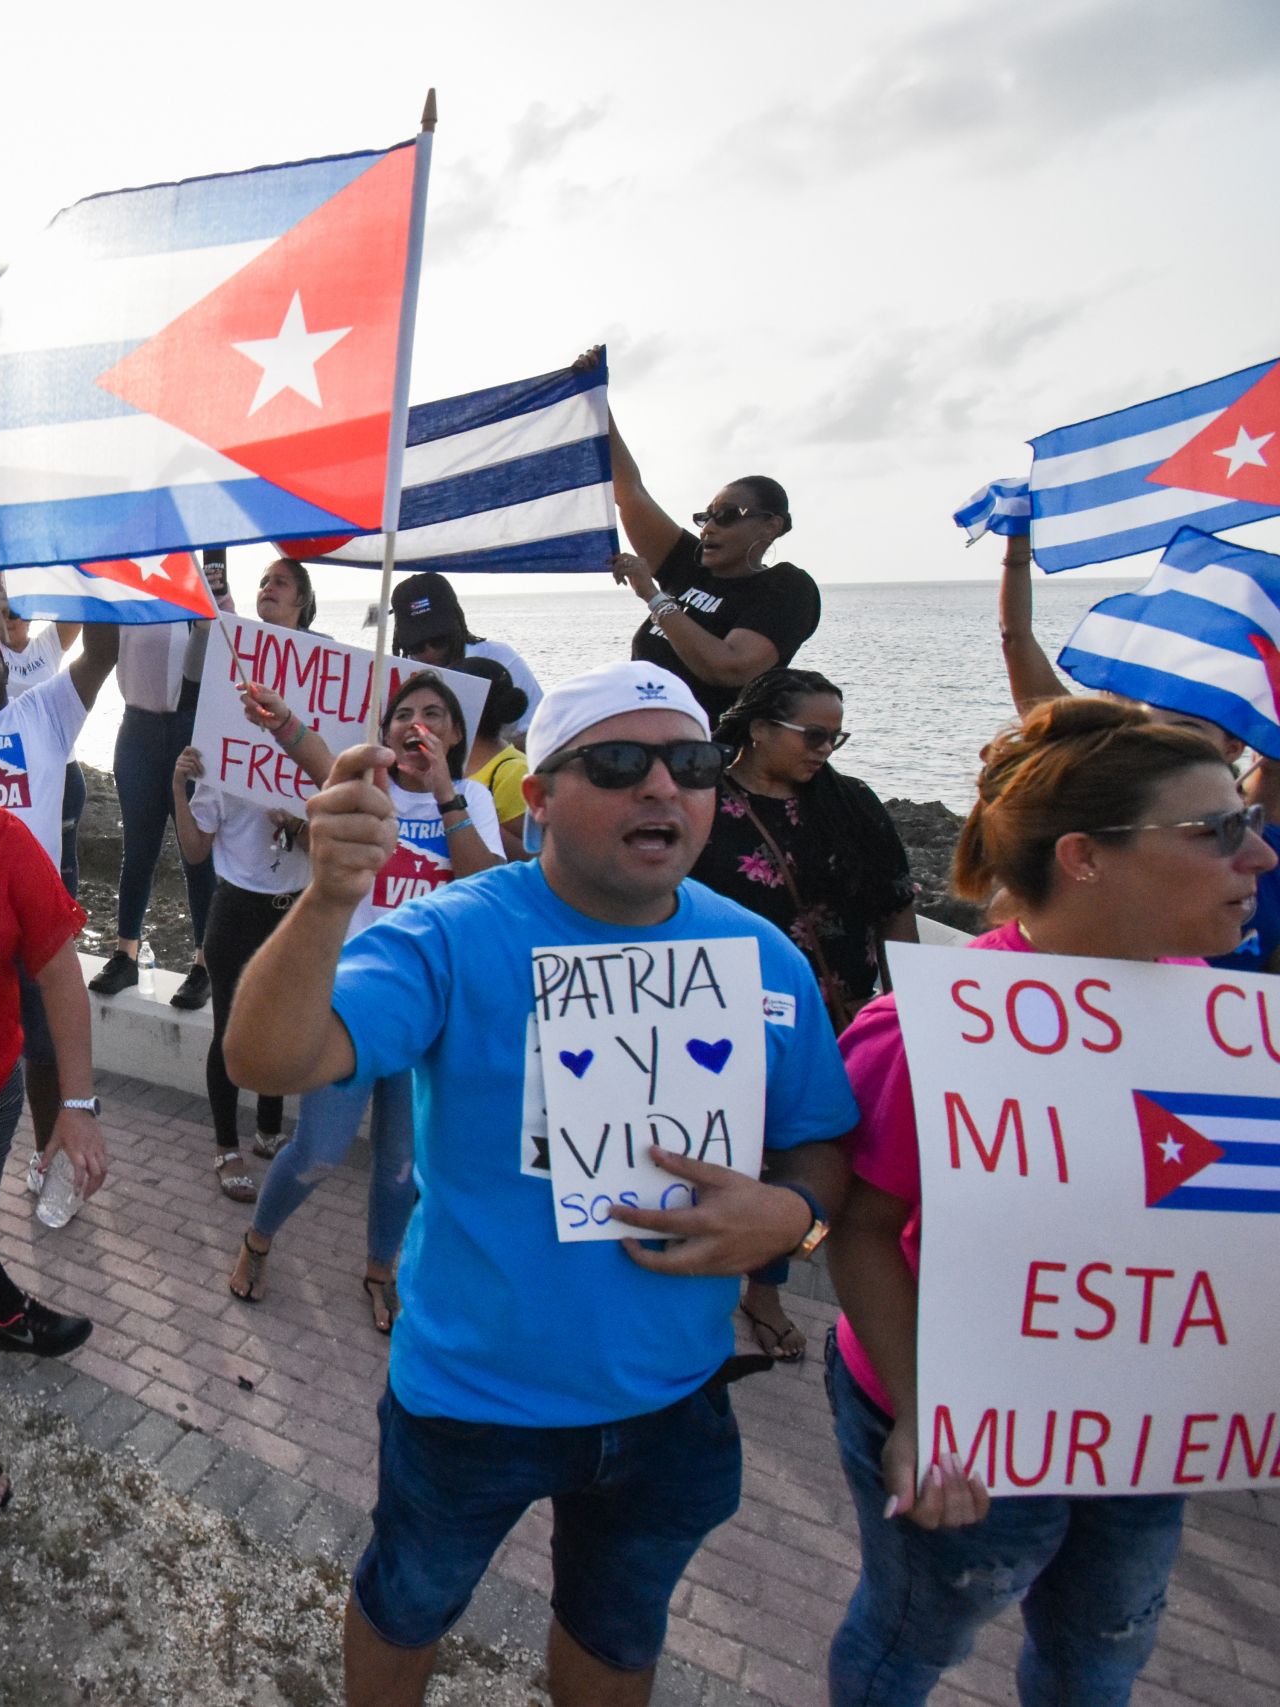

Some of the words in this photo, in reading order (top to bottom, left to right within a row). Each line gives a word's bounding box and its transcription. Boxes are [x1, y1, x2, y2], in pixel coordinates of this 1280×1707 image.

[385, 875, 448, 906] VID
[414, 860, 423, 873] Y
[532, 946, 727, 1021] PATRIA
[949, 977, 1123, 1056] SOS
[614, 1025, 658, 1106] Y
[559, 1109, 733, 1180] VIDA
[943, 1091, 1070, 1185] MI
[1020, 1260, 1229, 1349] ESTA
[930, 1404, 1280, 1489] MURIEN
